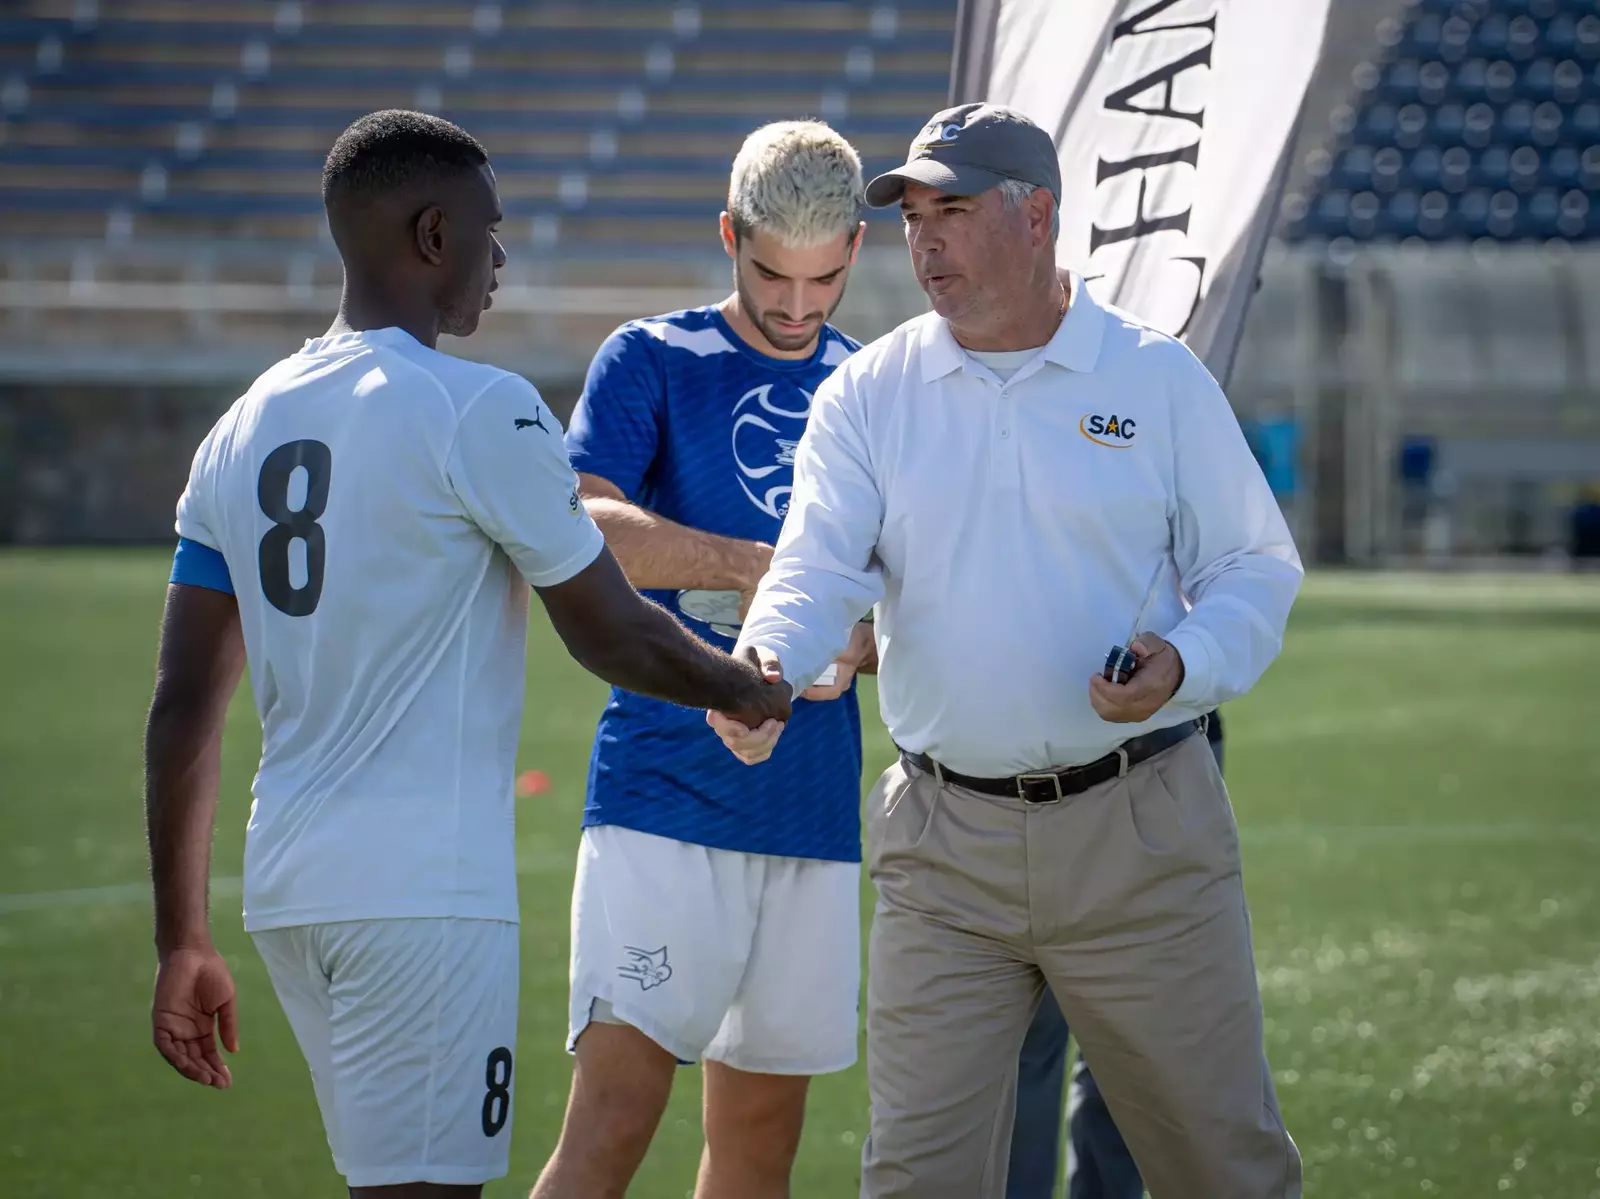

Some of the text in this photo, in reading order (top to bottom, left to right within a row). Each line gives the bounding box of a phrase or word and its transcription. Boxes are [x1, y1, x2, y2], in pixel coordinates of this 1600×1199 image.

[1088, 414, 1136, 439] SAC
[257, 439, 331, 617] 8
[482, 1046, 512, 1137] 8
